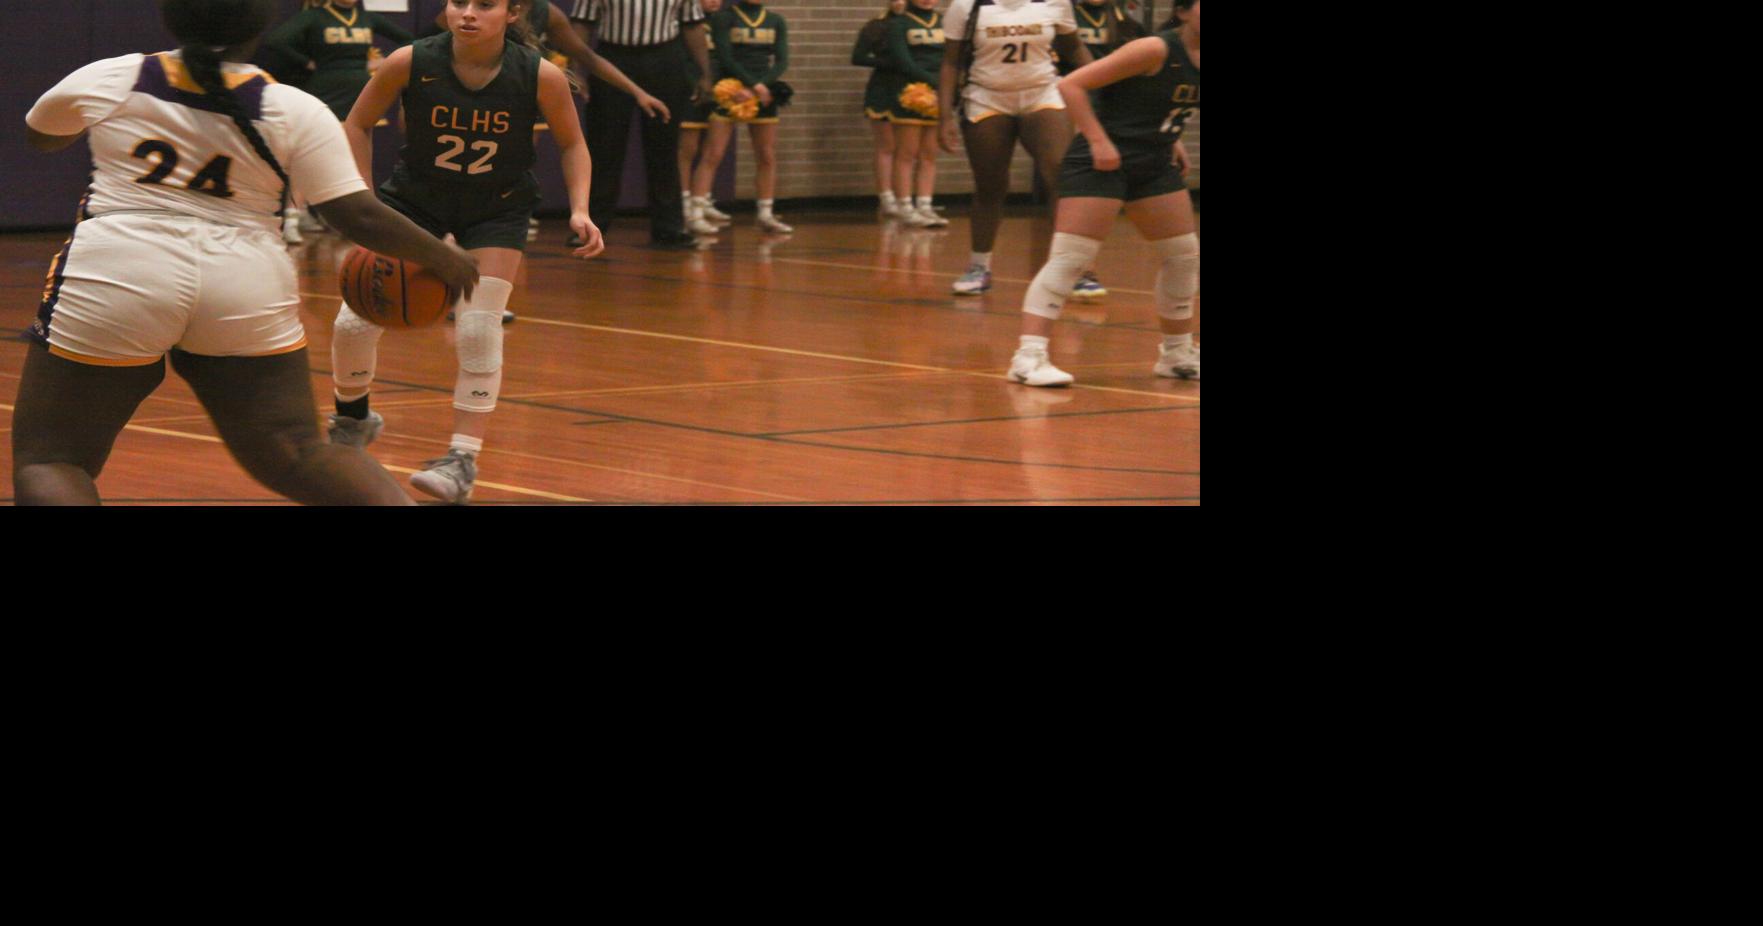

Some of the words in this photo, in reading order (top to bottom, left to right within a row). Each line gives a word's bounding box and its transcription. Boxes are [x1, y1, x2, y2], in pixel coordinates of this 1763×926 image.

[1001, 42, 1028, 64] 21
[431, 105, 510, 134] CLHS
[129, 137, 235, 198] 24
[434, 134, 498, 174] 22
